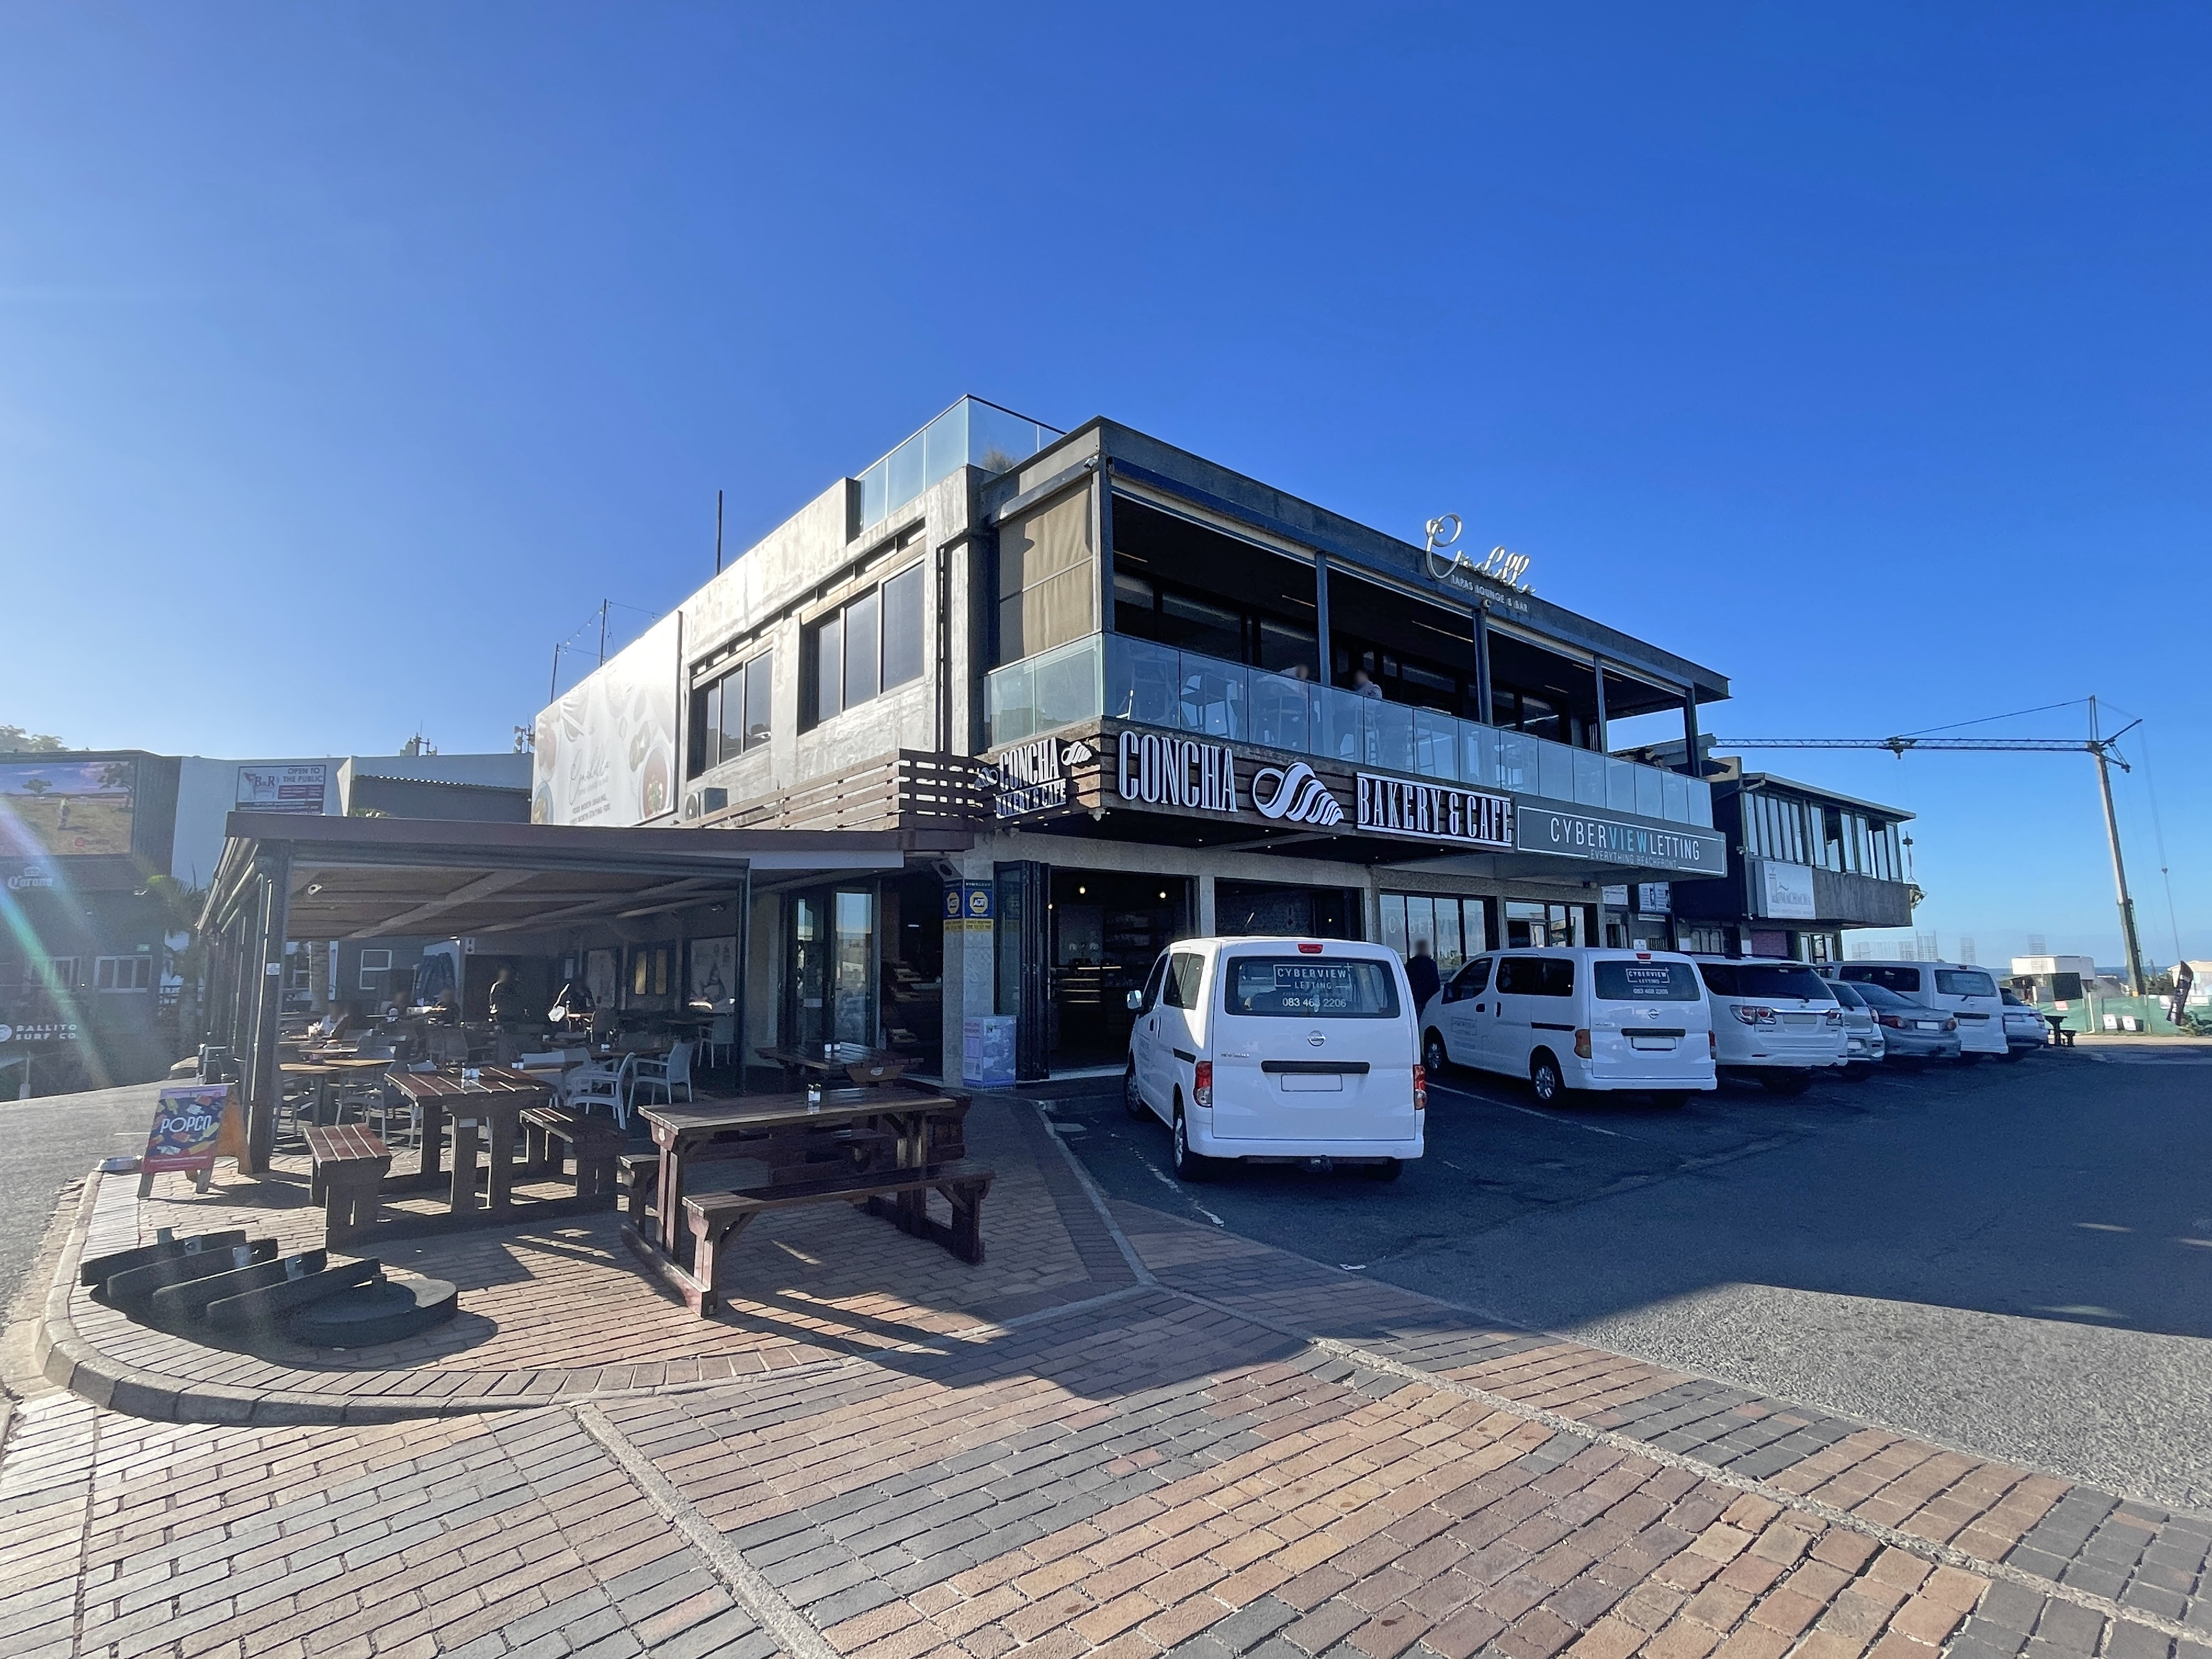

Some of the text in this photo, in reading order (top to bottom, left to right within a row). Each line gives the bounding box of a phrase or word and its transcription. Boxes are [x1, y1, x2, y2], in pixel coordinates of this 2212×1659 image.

[1450, 574, 1474, 591] TAPAS
[1474, 584, 1505, 603] LOUNGE
[1513, 600, 1528, 613] BAR
[998, 737, 1060, 792] CONCHA
[1119, 730, 1239, 812] CONCHA
[996, 781, 1066, 816] BAKERY & CAFE
[1357, 777, 1513, 842] BAKERY & CAFE
[1590, 849, 1677, 869] EVERYTHING BEACHFRONT
[1277, 968, 1347, 979] CYBERVIEW
[1294, 981, 1332, 989] LETTING
[1282, 997, 1300, 1007] 083
[1323, 998, 1347, 1007] 2206
